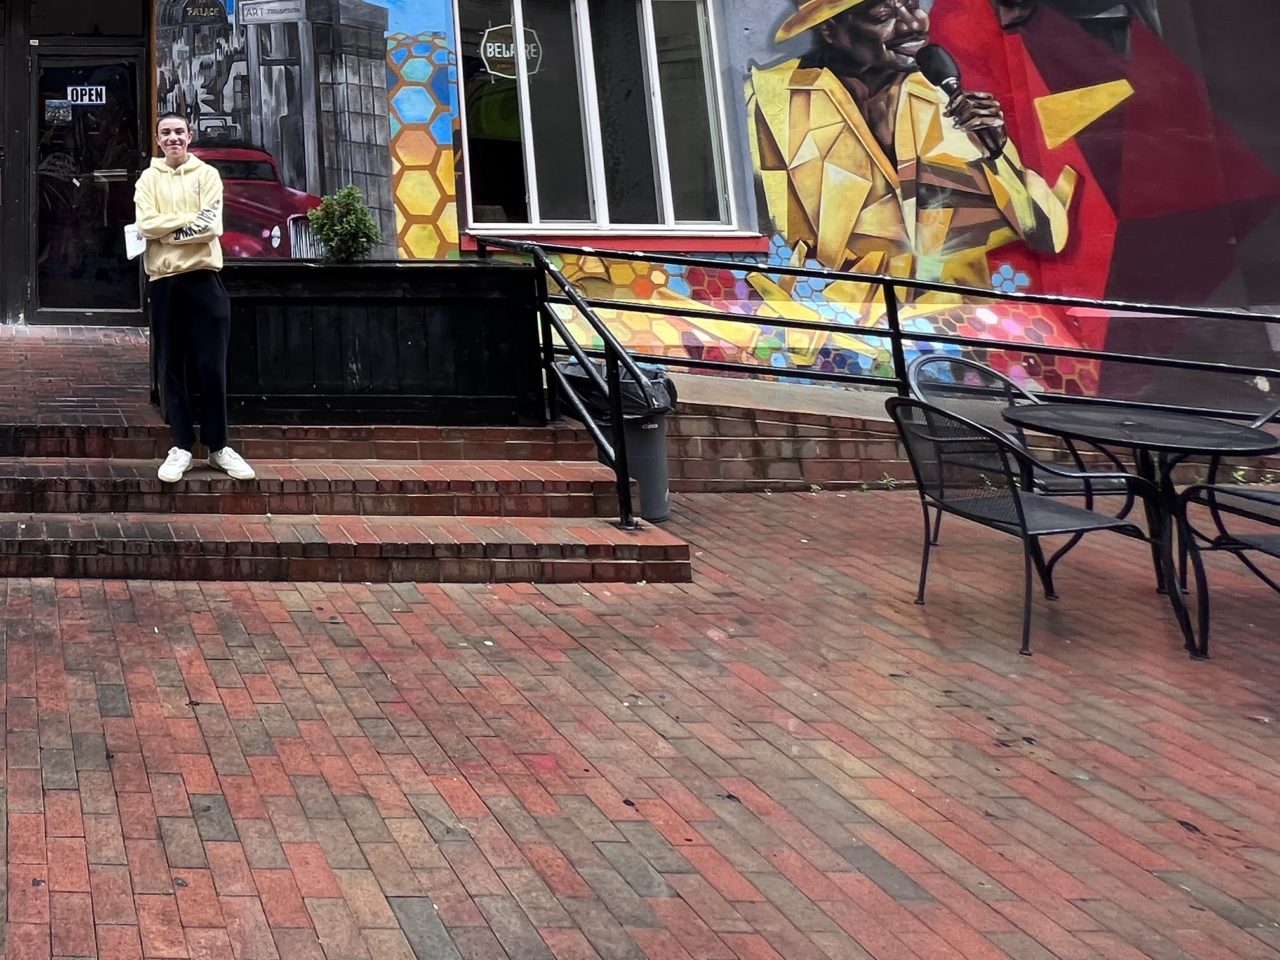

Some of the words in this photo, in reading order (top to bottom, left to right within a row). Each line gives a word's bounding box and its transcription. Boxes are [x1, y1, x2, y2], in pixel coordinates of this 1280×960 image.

[246, 8, 265, 17] ART
[486, 43, 538, 59] BELARE
[70, 87, 104, 103] OPEN
